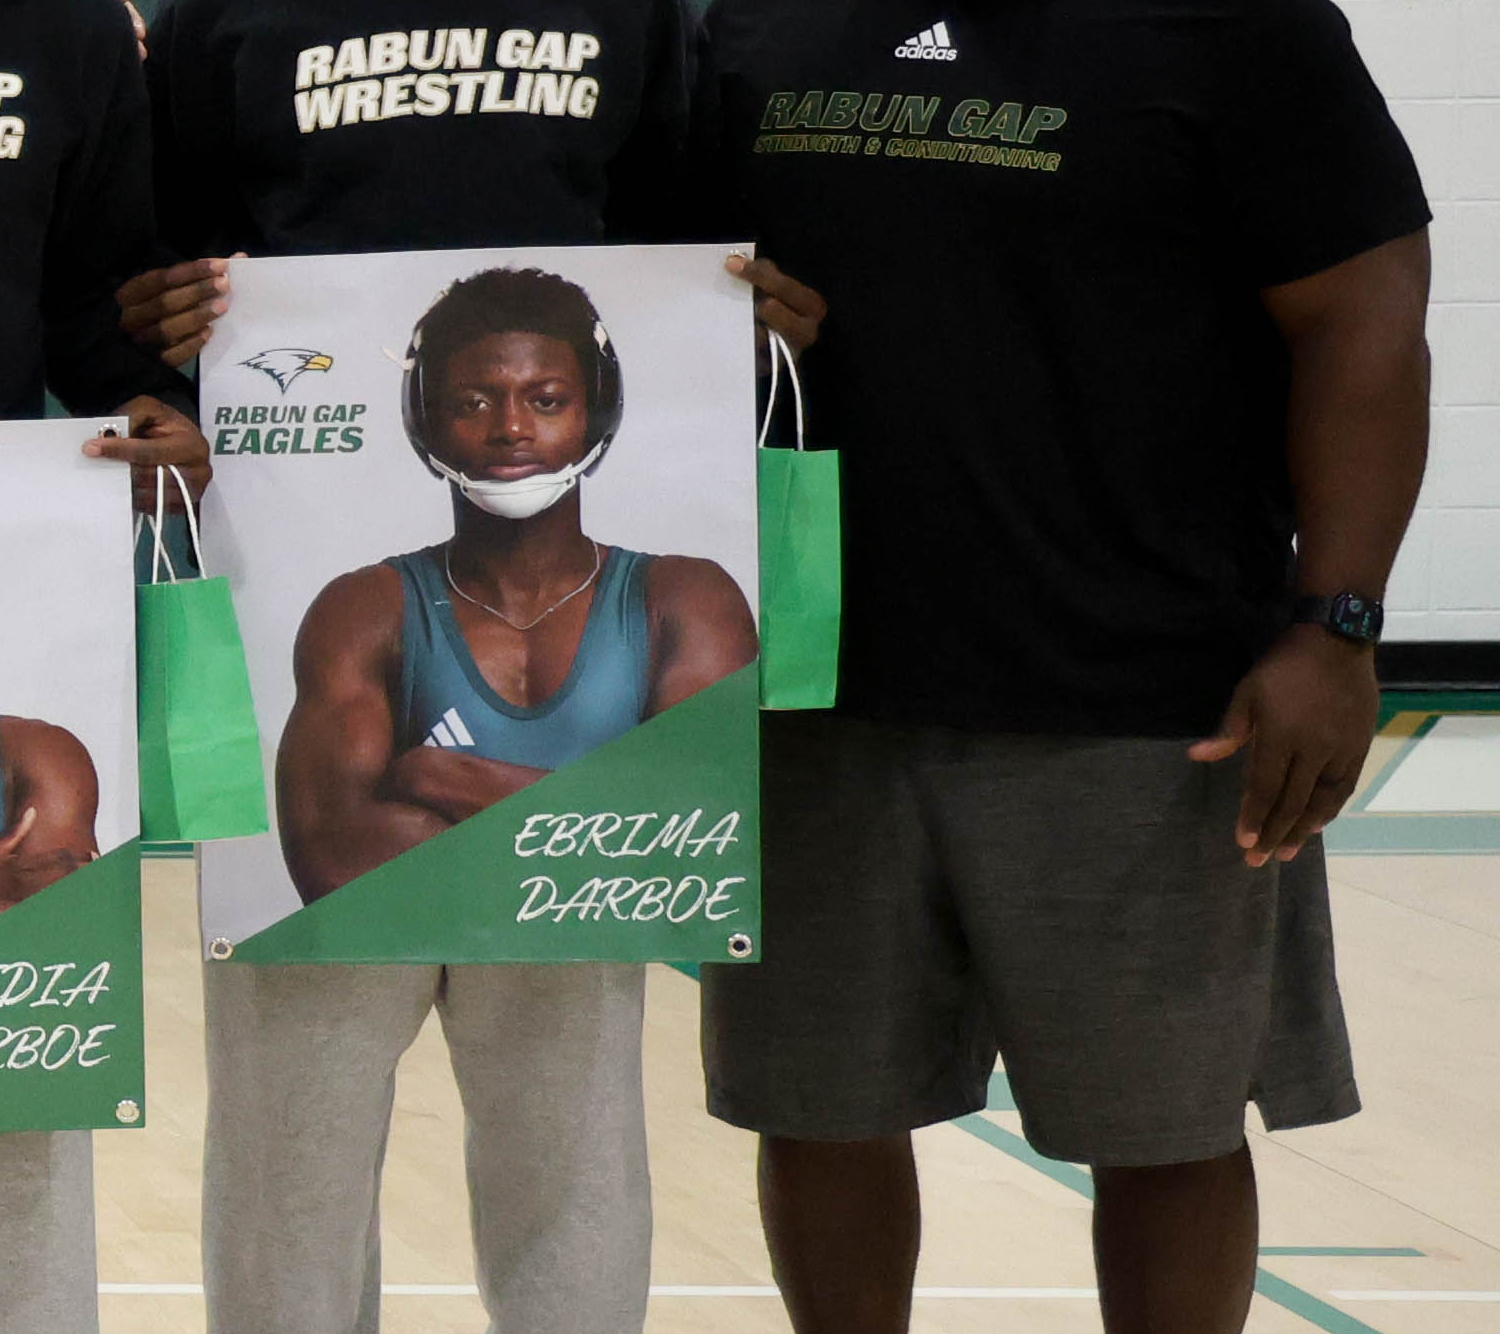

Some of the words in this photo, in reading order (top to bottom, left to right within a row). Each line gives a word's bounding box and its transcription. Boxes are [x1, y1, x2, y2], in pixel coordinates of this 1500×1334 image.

[294, 27, 488, 90] RABUN
[494, 28, 601, 72] GAP
[893, 44, 959, 62] adidas
[293, 70, 600, 134] WRESTLING
[759, 90, 942, 135] RABUN
[947, 99, 1068, 144] GAP
[863, 137, 883, 156] &
[885, 137, 1062, 172] CONDITIONING
[213, 404, 310, 426] RABUN
[312, 403, 367, 424] GAP
[213, 426, 365, 456] EAGLES
[513, 808, 740, 858] EBRIMA
[514, 875, 748, 924] DARBOE
